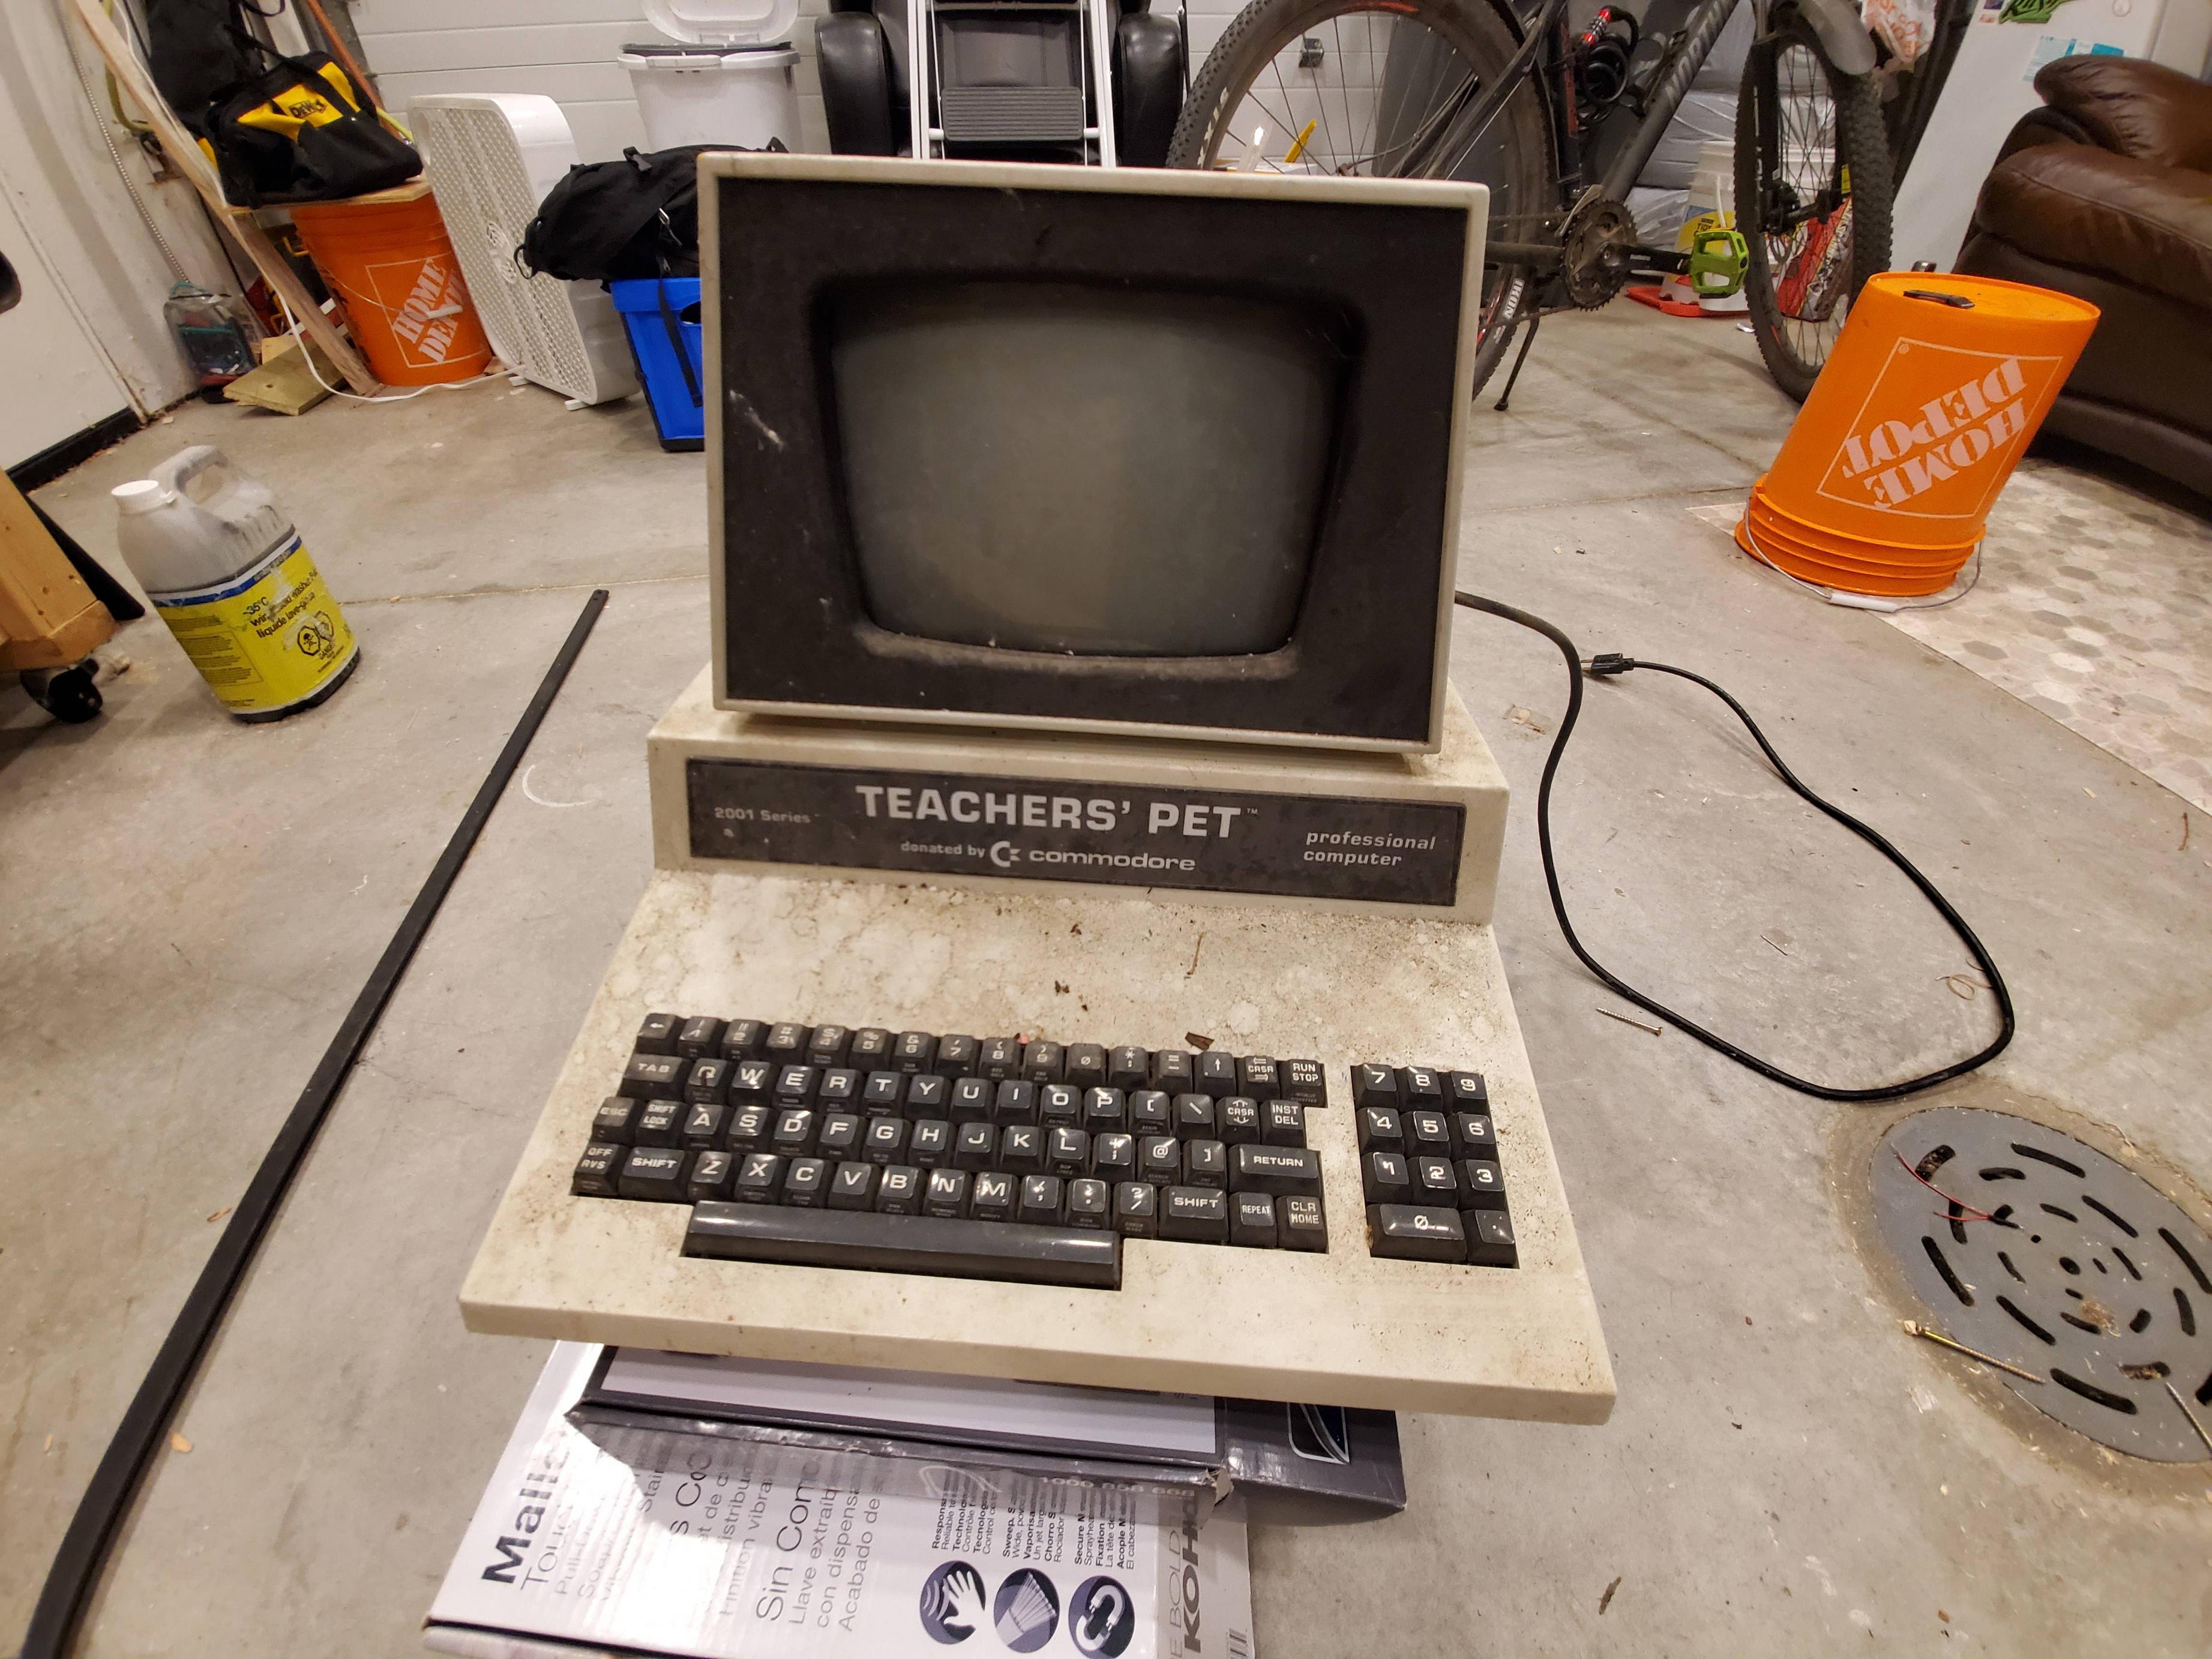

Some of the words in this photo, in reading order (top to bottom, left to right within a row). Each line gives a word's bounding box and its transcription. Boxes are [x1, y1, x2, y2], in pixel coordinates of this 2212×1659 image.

[392, 258, 446, 344] HOME
[1504, 279, 1524, 319] IKON
[1842, 359, 2027, 479] DEPOT
[1864, 398, 2027, 509] HOME
[256, 614, 287, 639] liquide
[714, 806, 754, 821] 2001
[760, 809, 811, 824] Series
[1148, 802, 1242, 838] PET
[1306, 829, 1437, 851] professional
[901, 840, 963, 857] donated
[967, 843, 986, 859] by
[1029, 850, 1196, 872] commodore
[1303, 848, 1402, 868] computer
[992, 1050, 1004, 1060] 8
[637, 1063, 671, 1073] TAB
[741, 1067, 765, 1082] W
[1293, 1063, 1316, 1072] RUN
[785, 1072, 805, 1086] E
[829, 1076, 848, 1089] R
[1292, 1072, 1319, 1082] STOP
[1370, 1071, 1386, 1084] 7
[1415, 1074, 1431, 1087] 8
[875, 1078, 892, 1092] T
[919, 1082, 936, 1096] Y
[962, 1085, 980, 1099] U
[1461, 1078, 1476, 1092] 9
[1051, 1092, 1069, 1106] O
[1097, 1096, 1113, 1109] P
[600, 1106, 628, 1117] ESC
[648, 1103, 677, 1114] SHIFT
[1272, 1103, 1299, 1115] INST
[643, 1115, 669, 1125] LOCK
[693, 1113, 711, 1127] A
[739, 1114, 759, 1127] S
[783, 1118, 803, 1132] D
[1274, 1115, 1299, 1126] DEL
[1376, 1116, 1393, 1130] 4
[1423, 1120, 1439, 1133] 5
[829, 1121, 850, 1136] F
[876, 1126, 895, 1139] G
[921, 1127, 940, 1142] H
[1468, 1122, 1485, 1136] 6
[968, 1132, 985, 1144] J
[1013, 1133, 1031, 1148] K
[1060, 1137, 1077, 1151] L
[588, 1147, 613, 1157] OFF
[580, 1159, 607, 1169] RVS
[631, 1157, 678, 1169] SHIFT
[700, 1160, 723, 1174] Z
[1253, 1156, 1304, 1167] RETURN
[1383, 1161, 1396, 1175] 1
[748, 1162, 769, 1177] X
[795, 1167, 815, 1181] C
[1429, 1166, 1446, 1180] 2
[1477, 1169, 1493, 1183] 3
[844, 1171, 862, 1186] V
[889, 1174, 909, 1189] B
[937, 1178, 957, 1192] N
[982, 1182, 1007, 1197] M
[1174, 1197, 1219, 1209] SHIFT
[1242, 1204, 1271, 1215] REPEAT
[1291, 1201, 1317, 1212] CLR
[1291, 1213, 1320, 1225] HOME
[705, 1493, 722, 1520] de
[940, 1510, 954, 1550] Reliable
[982, 1517, 995, 1555] Control
[1036, 1529, 1045, 1544] jet
[1044, 1522, 1055, 1561] Chorro
[1054, 1516, 1065, 1562] Rociador
[1075, 1525, 1085, 1565] Secure
[1095, 1523, 1105, 1567] Fixation
[1033, 1545, 1041, 1560] Un
[1117, 1530, 1127, 1569] Acople
[838, 1531, 873, 1632] Acabado
[864, 1498, 880, 1524] de
[1105, 1555, 1114, 1568] La
[1126, 1559, 1134, 1570] El
[1169, 1530, 1182, 1628] BOLD
[756, 1566, 793, 1621] Sin
[789, 1567, 817, 1624] Llave
[817, 1586, 837, 1628] con
